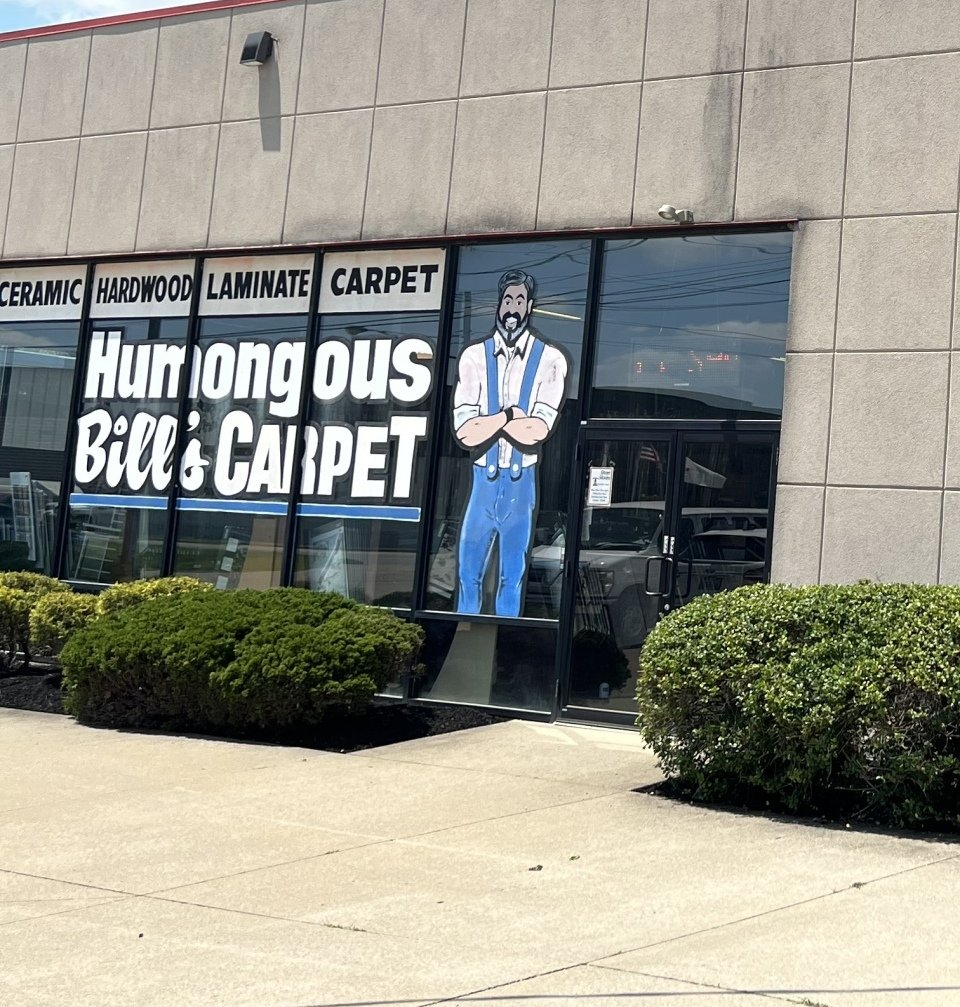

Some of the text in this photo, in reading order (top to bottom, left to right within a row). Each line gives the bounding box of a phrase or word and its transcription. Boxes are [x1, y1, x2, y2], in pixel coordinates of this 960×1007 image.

[0, 279, 82, 307] CERAMIC
[96, 274, 194, 304] HARDWOOD
[206, 269, 311, 300] LAMINATE
[330, 264, 439, 297] CARPET
[84, 331, 433, 418] Humongous
[75, 409, 428, 499] Bill's CARPET
